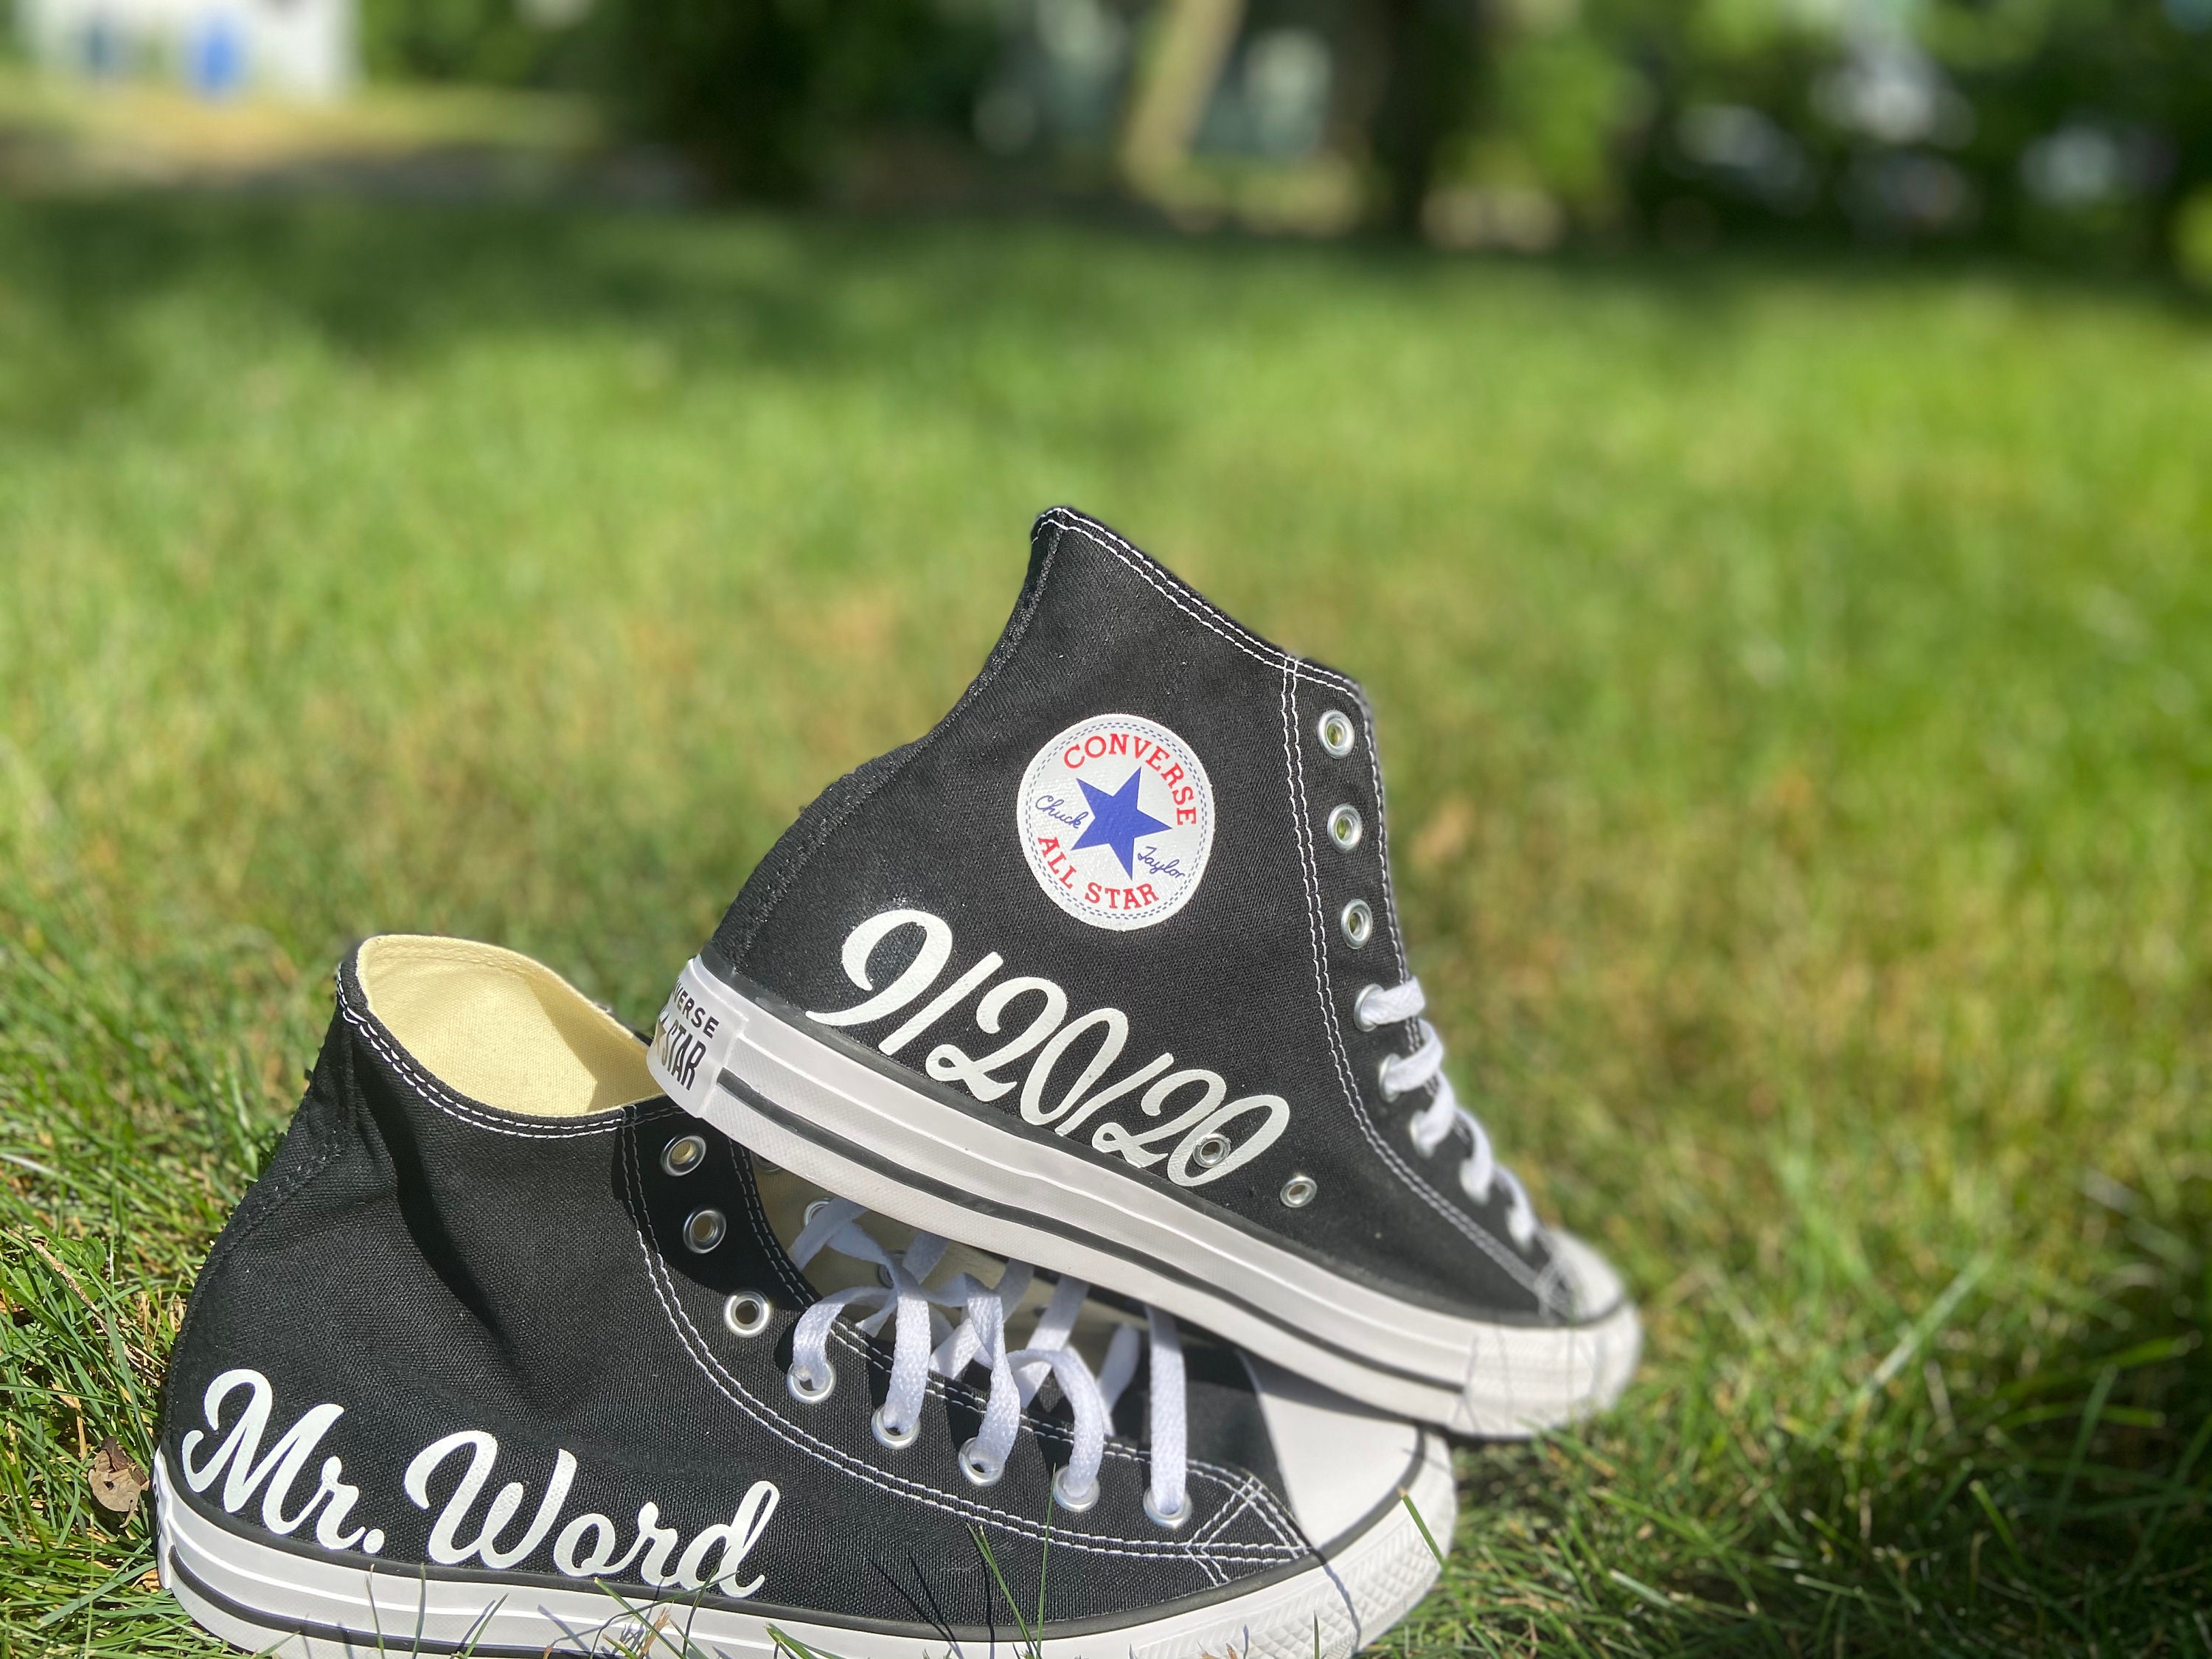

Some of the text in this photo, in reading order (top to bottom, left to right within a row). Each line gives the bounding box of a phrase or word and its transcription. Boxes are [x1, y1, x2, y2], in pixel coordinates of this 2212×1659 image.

[1035, 795, 1089, 830] Chuck
[1064, 734, 1196, 826] CONVERSE
[1037, 837, 1158, 910] ALL STAR
[1138, 846, 1186, 878] Taylor
[661, 1019, 706, 1091] STAR
[805, 908, 1290, 1187] 9/20/20
[181, 1368, 780, 1597] Mr. Word
